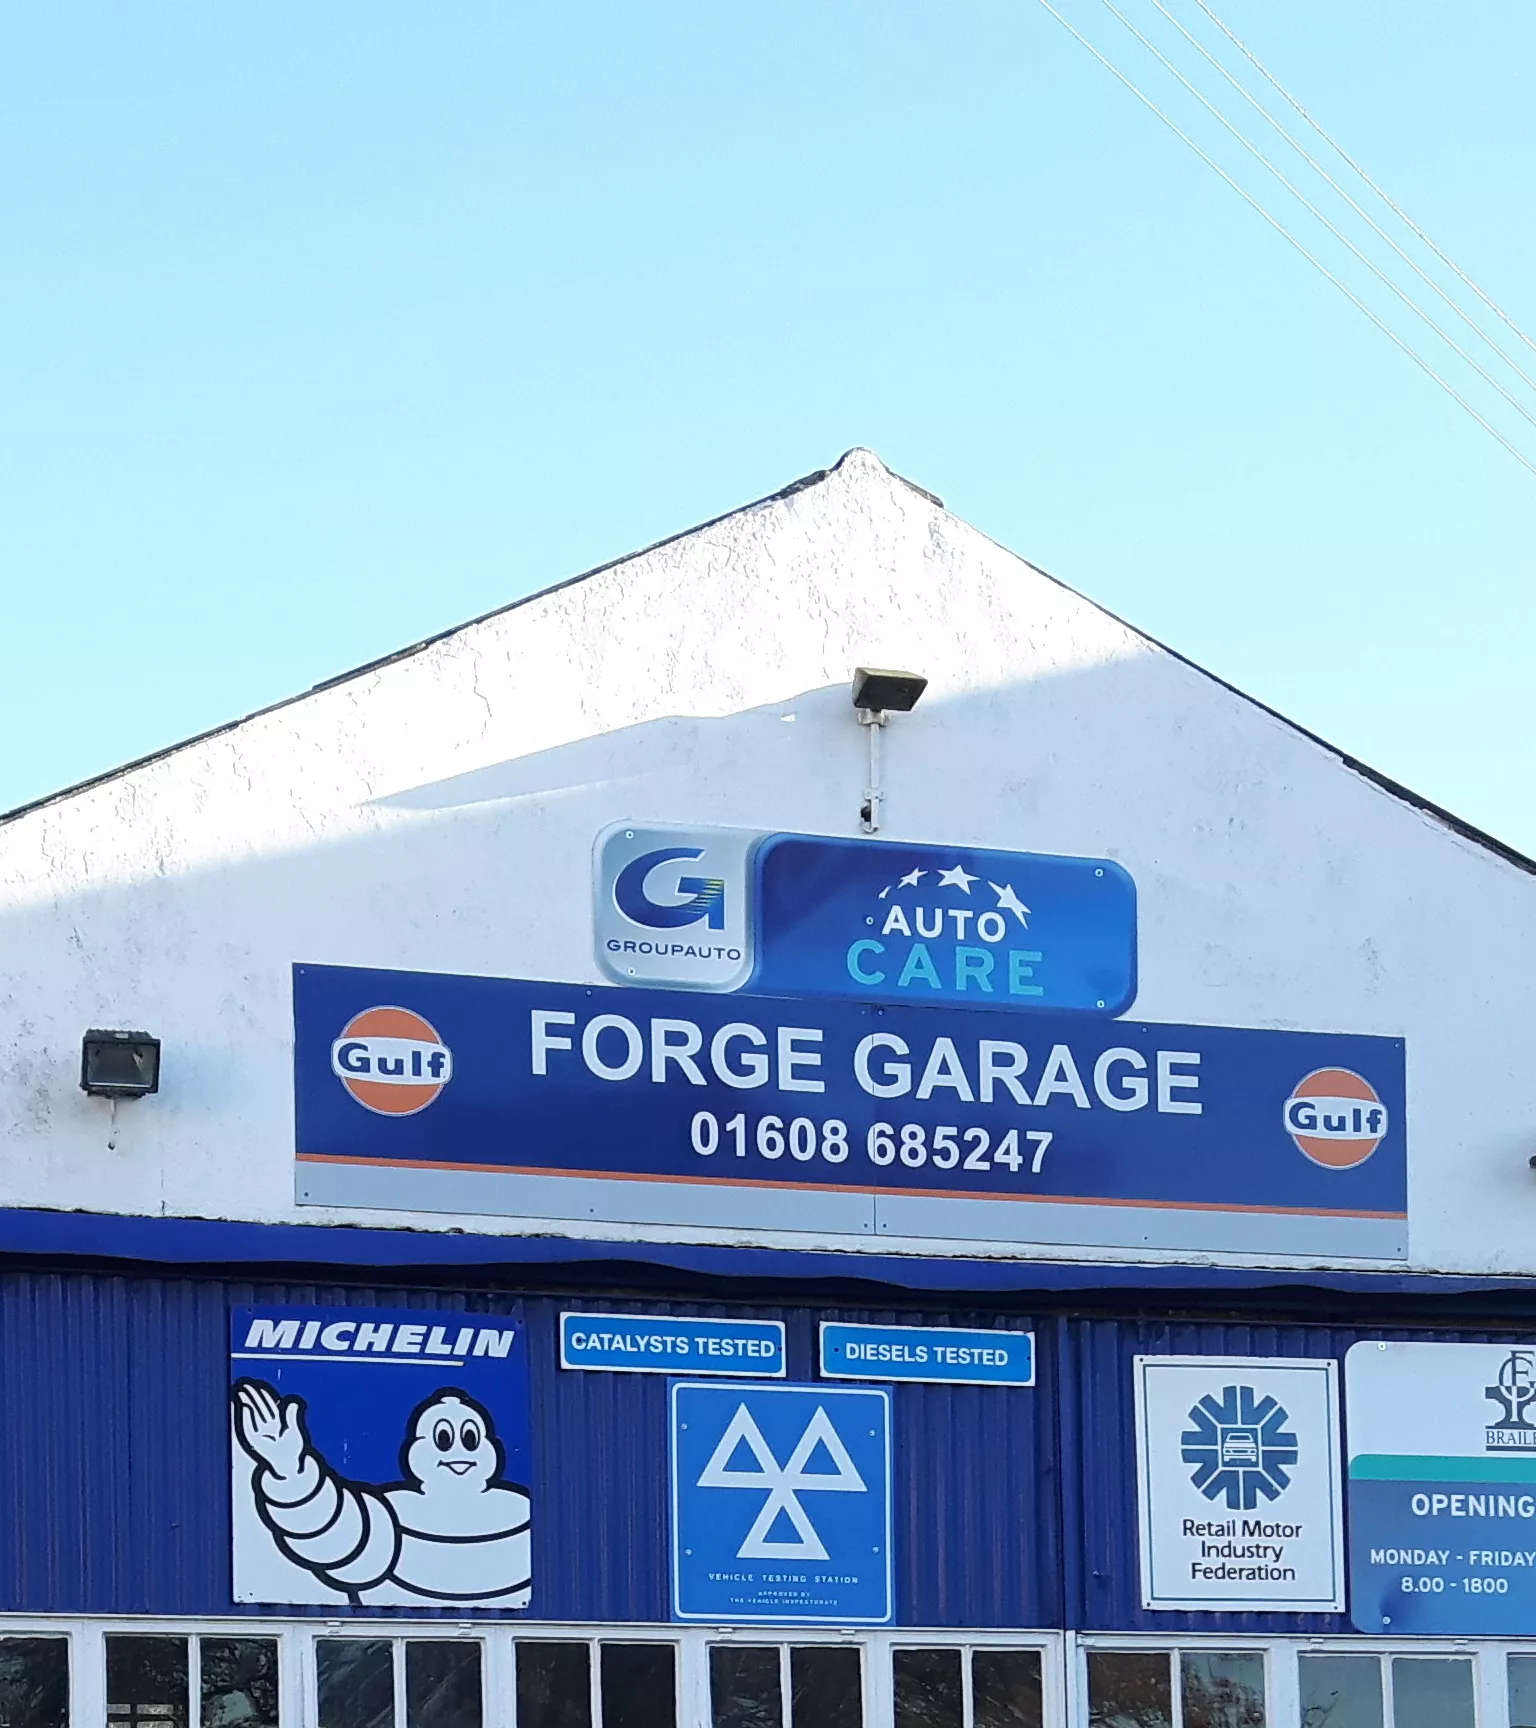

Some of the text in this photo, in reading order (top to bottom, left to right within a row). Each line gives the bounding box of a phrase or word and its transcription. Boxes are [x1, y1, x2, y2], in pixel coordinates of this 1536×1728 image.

[880, 904, 1006, 944] AUTO
[606, 938, 742, 962] GROUPAUTO
[846, 938, 1045, 997] CARE
[337, 1041, 447, 1079] Gulf
[530, 1009, 1203, 1115] FORGE GARAGE
[1288, 1101, 1383, 1134] Gulf
[690, 1110, 1054, 1174] 01608 685247
[243, 1318, 515, 1359] MICHELIN
[570, 1332, 776, 1359] CATALYSTS TESTED
[845, 1341, 1009, 1367] DIESELS TESTED
[1410, 1492, 1536, 1519] OPENING
[1182, 1518, 1303, 1539] Retail Motor
[1201, 1540, 1284, 1563] Industry
[1370, 1548, 1451, 1566] MONDAY
[708, 1572, 859, 1585] VEHICLE TESTING STATION
[1191, 1562, 1296, 1581] Federation
[1401, 1576, 1445, 1594] 8.00
[1463, 1577, 1509, 1594] 1800
